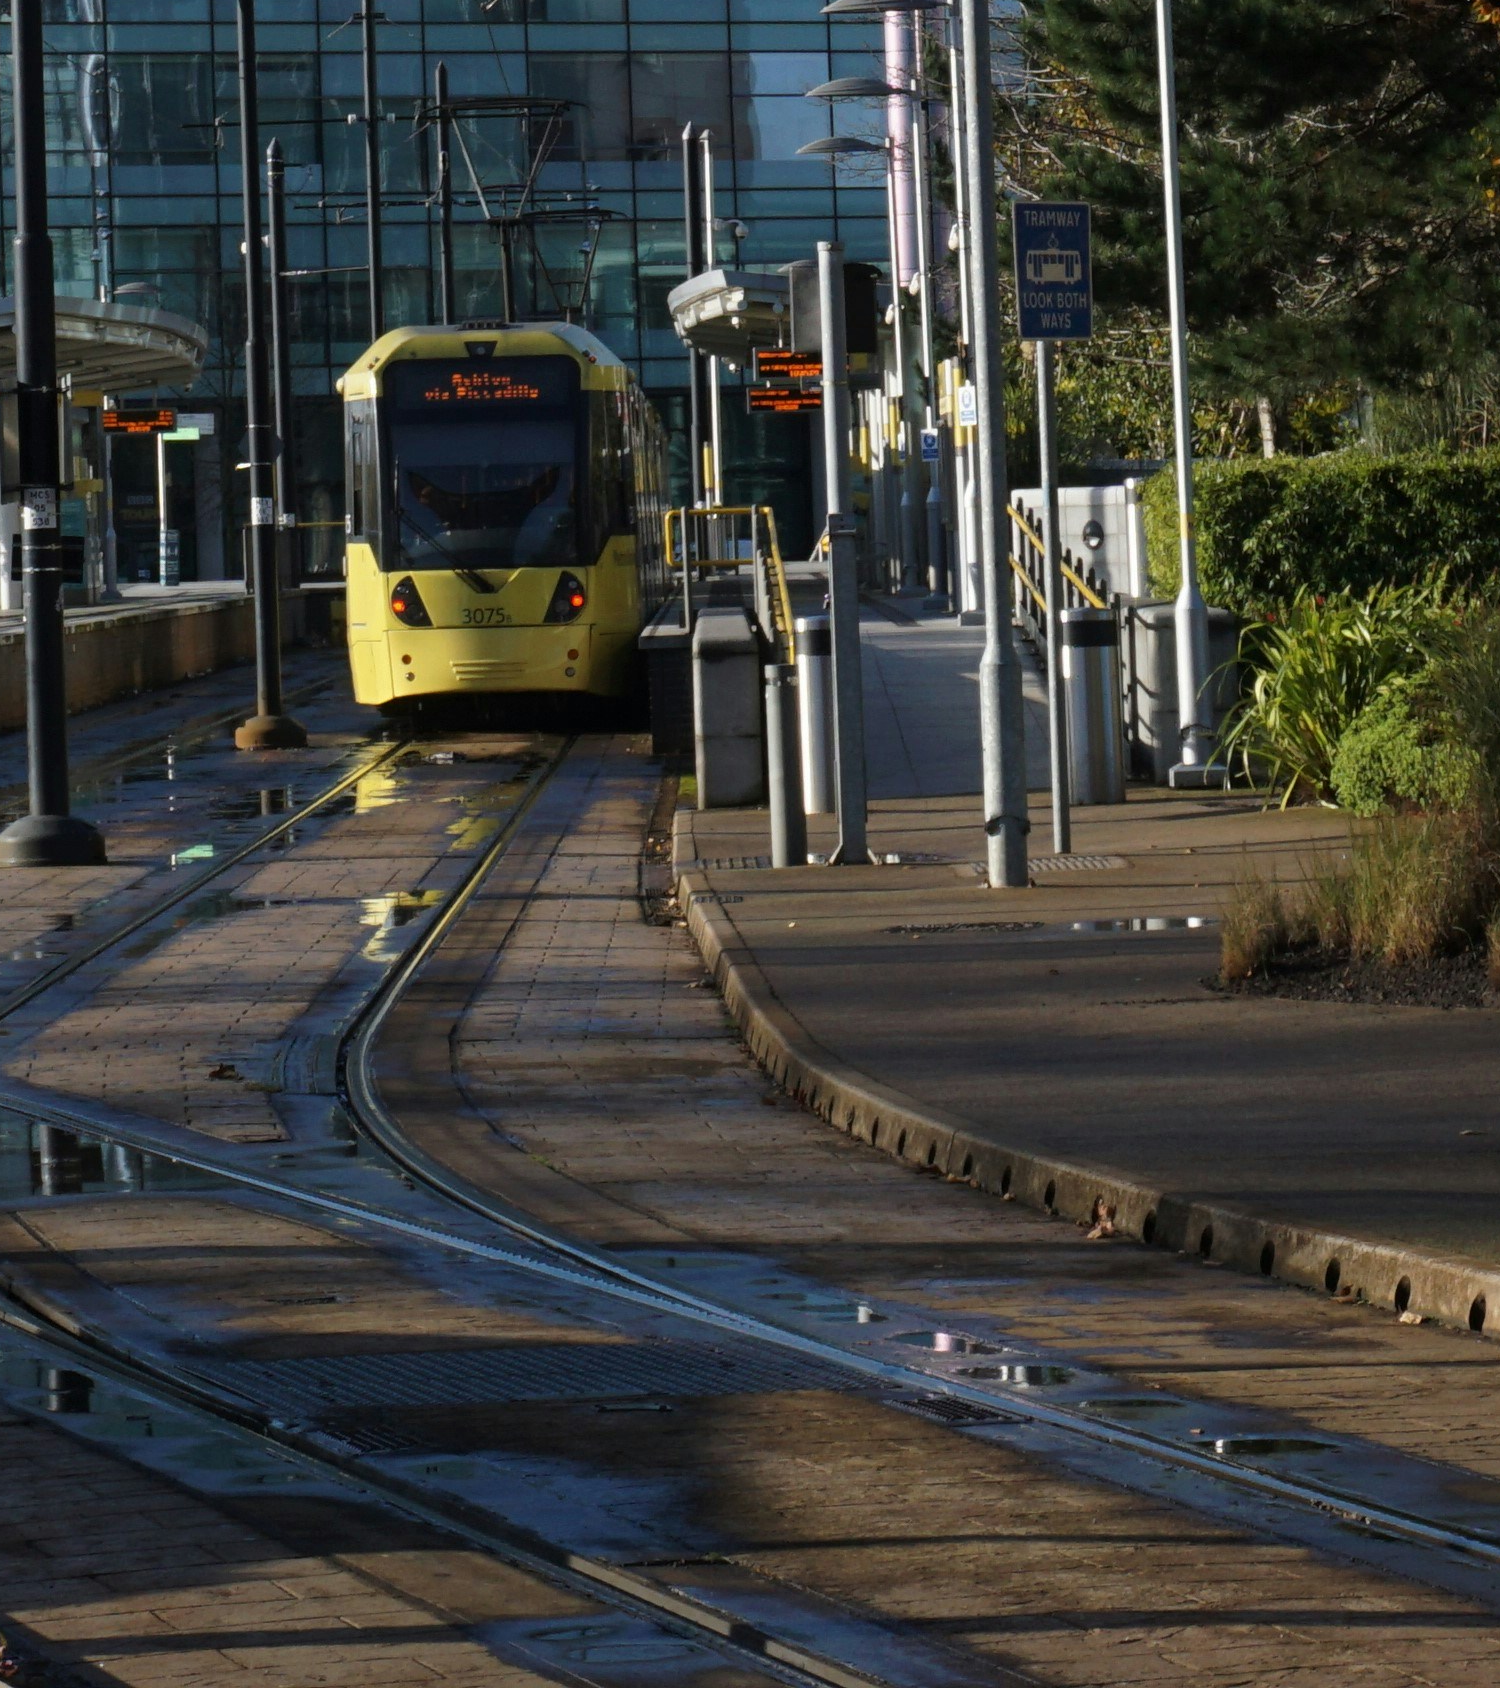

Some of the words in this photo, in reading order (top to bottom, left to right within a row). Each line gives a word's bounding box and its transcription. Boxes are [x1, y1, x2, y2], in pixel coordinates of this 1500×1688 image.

[1024, 210, 1081, 227] TRAMWAY
[1023, 292, 1054, 309] LOOK
[1057, 293, 1088, 310] BOTH
[1041, 312, 1072, 330] WAYS
